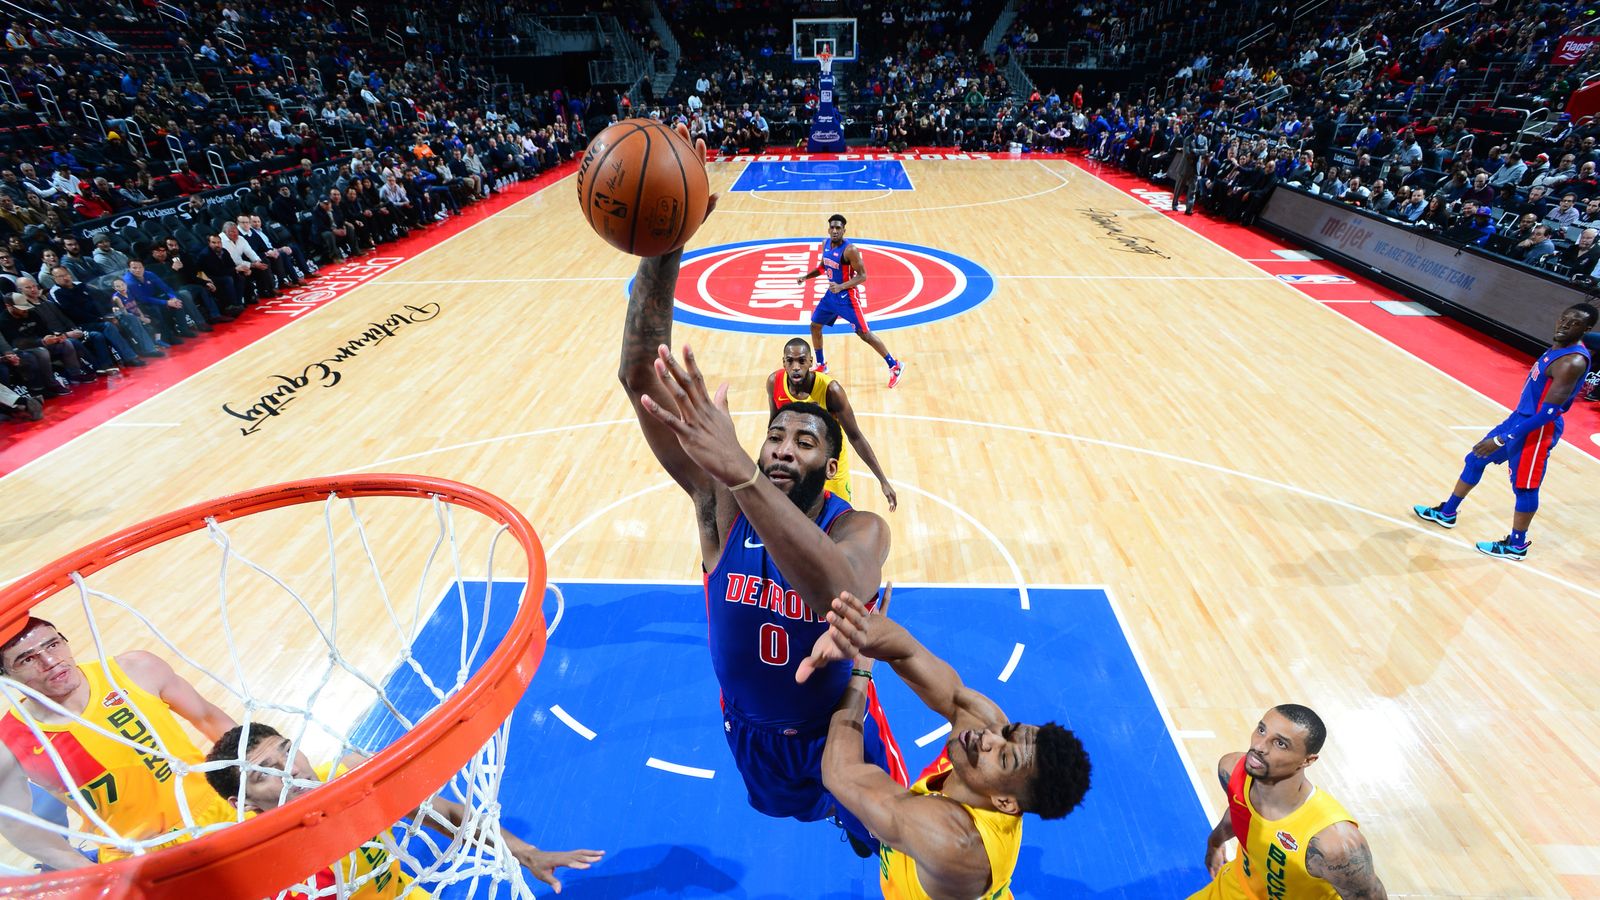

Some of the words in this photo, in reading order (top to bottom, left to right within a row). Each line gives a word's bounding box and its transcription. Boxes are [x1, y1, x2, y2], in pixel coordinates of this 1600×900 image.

[1562, 41, 1593, 53] Flagst
[834, 153, 993, 161] PISTONS
[1321, 217, 1374, 249] meijer
[748, 251, 810, 309] PISTONS
[1373, 240, 1389, 254] WE
[1385, 244, 1404, 262] ARE
[1401, 250, 1421, 268] THE
[1417, 258, 1449, 279] HOME
[264, 256, 405, 318] DETROIT
[325, 302, 441, 363] Platinum
[222, 361, 342, 436] Equity
[725, 573, 827, 623] DETROI
[760, 622, 790, 666] 0
